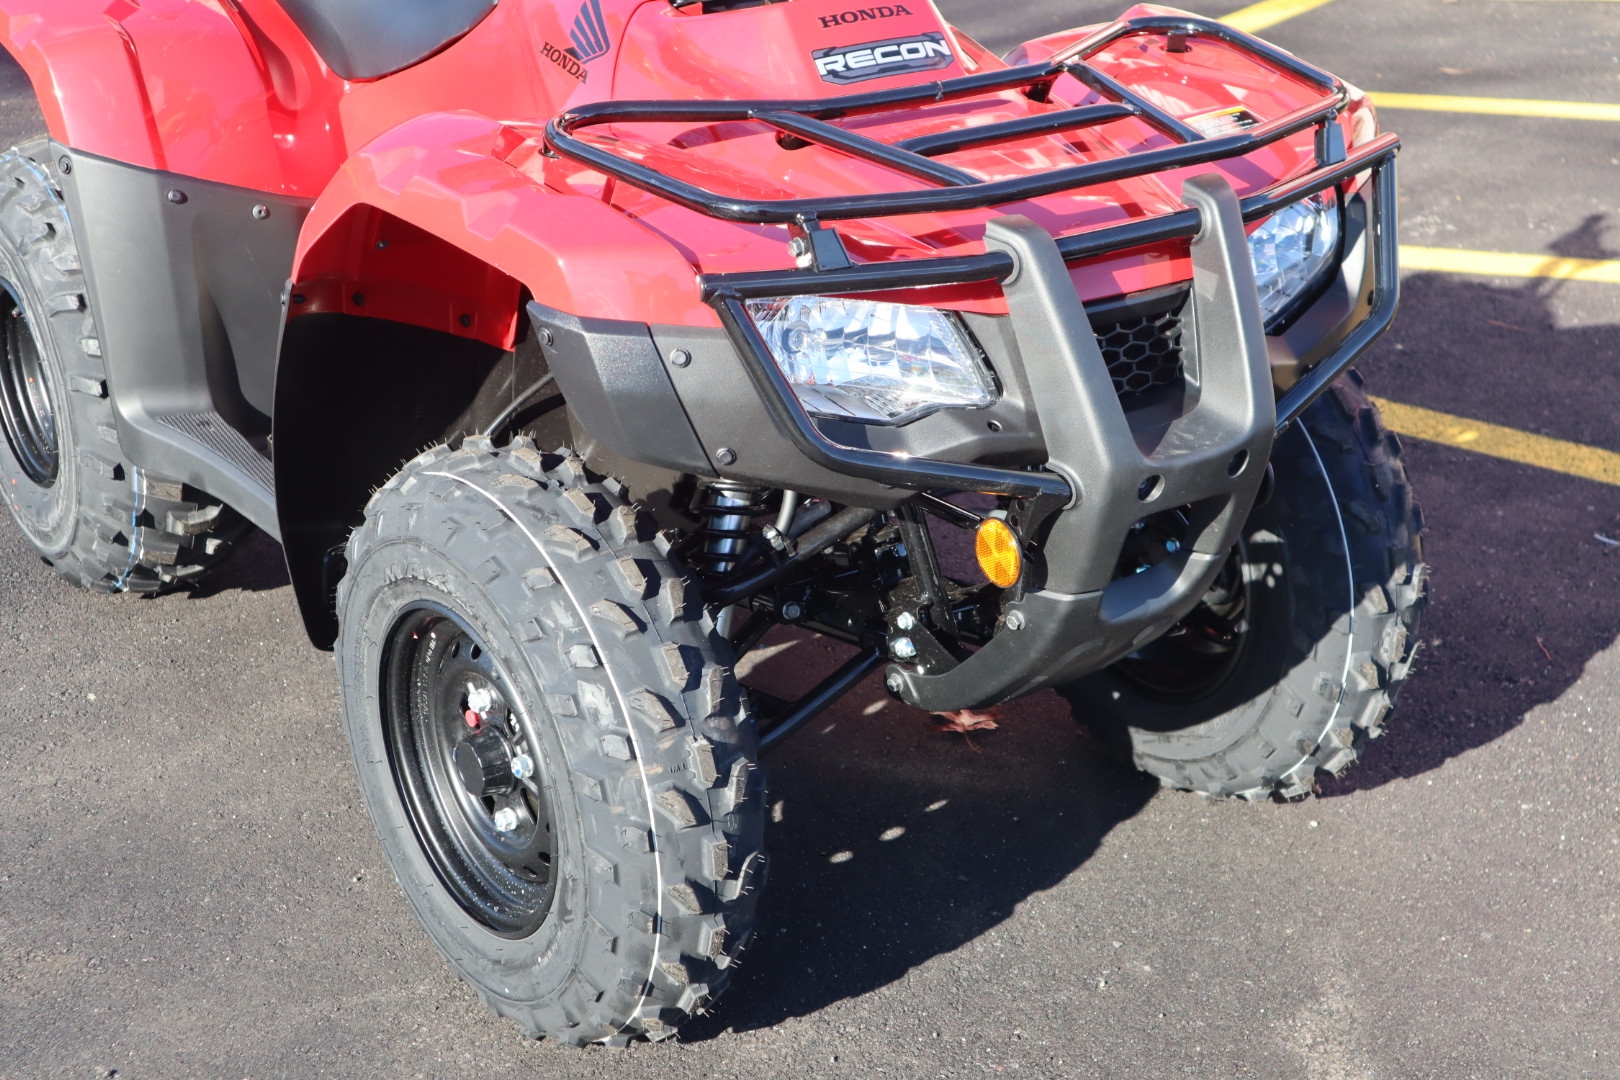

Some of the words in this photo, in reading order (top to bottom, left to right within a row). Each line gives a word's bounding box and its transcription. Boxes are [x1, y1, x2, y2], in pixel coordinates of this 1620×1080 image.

[818, 4, 913, 28] HONDA
[539, 41, 588, 85] HONDA
[814, 39, 952, 76] RECON
